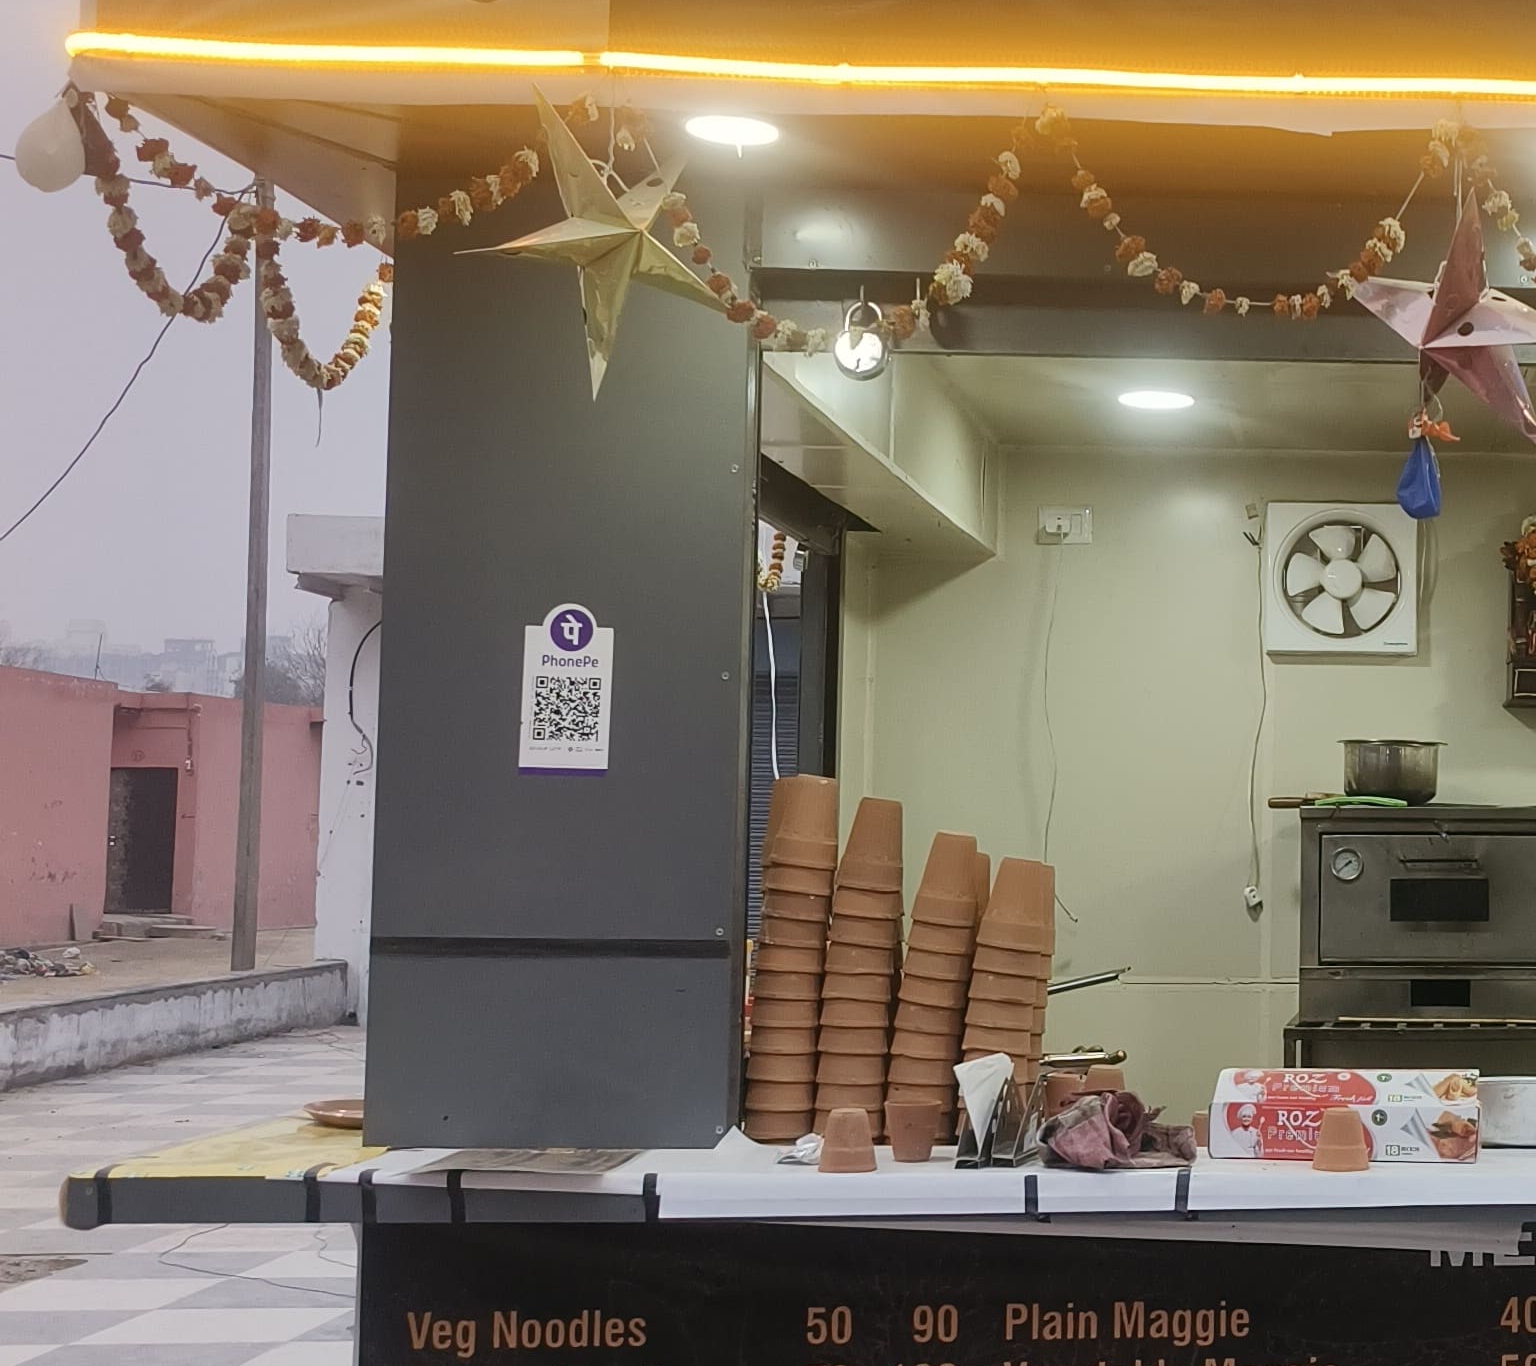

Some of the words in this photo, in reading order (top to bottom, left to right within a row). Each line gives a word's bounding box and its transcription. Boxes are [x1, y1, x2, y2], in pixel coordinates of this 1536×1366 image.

[541, 654, 600, 669] PhonePe
[1277, 1110, 1322, 1128] ROZ
[1386, 1145, 1400, 1156] 18
[408, 1313, 475, 1357] Veg
[494, 1311, 645, 1348] Noodles
[808, 1307, 851, 1344] 50
[914, 1305, 957, 1342] 90
[1006, 1304, 1097, 1340] Plain
[1114, 1302, 1249, 1346] Maggie
